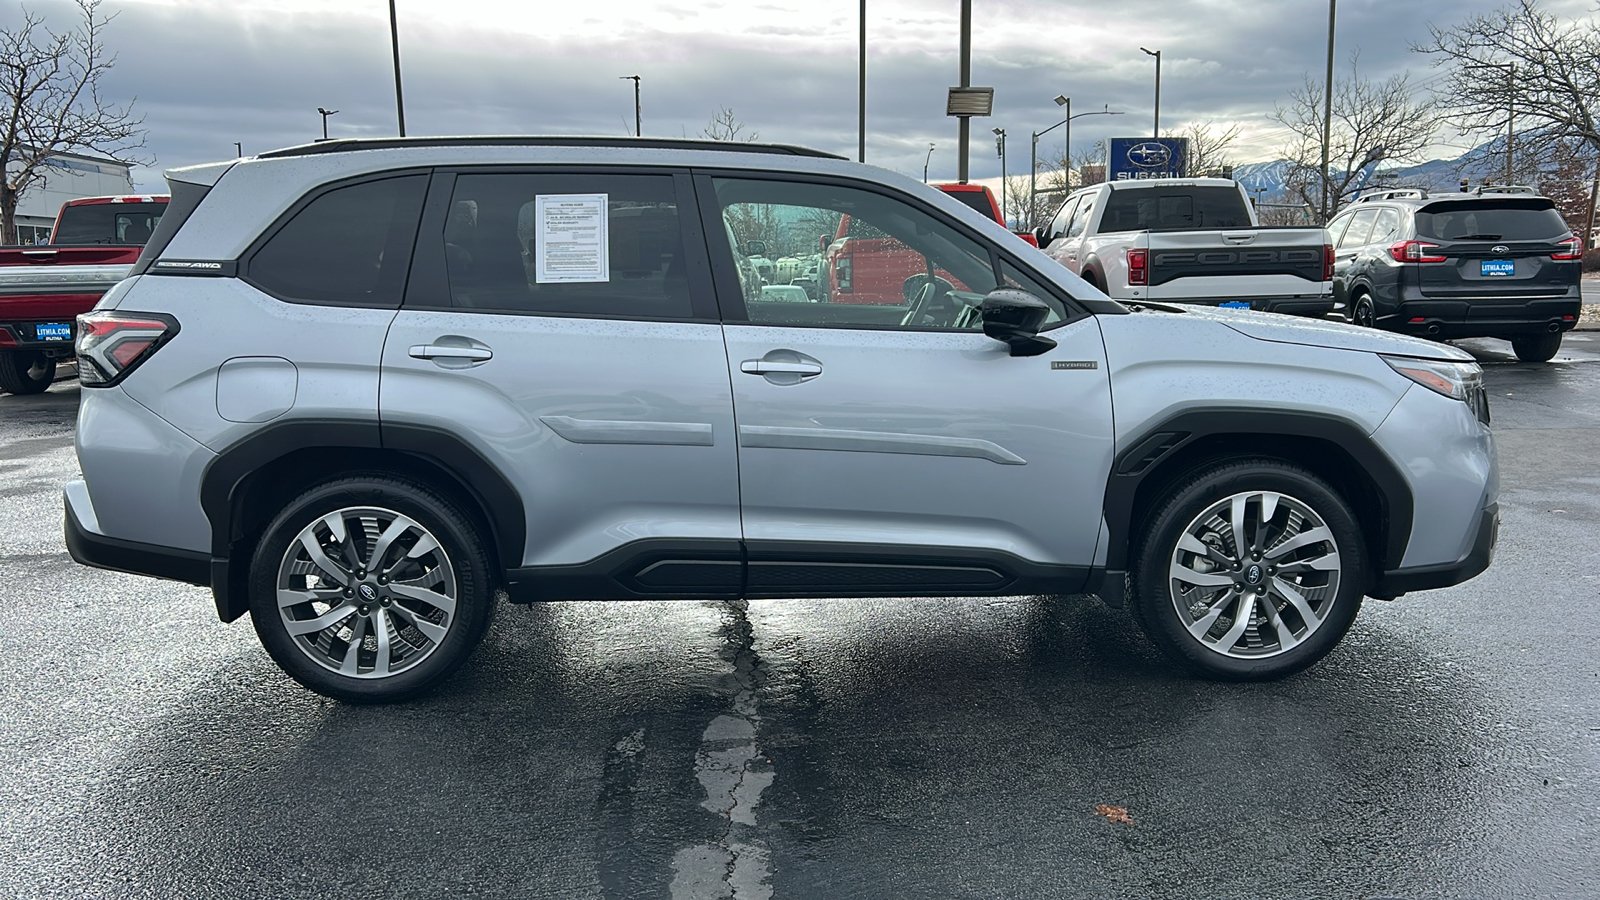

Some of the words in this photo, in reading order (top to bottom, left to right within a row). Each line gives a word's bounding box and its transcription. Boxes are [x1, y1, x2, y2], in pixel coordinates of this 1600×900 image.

[1117, 171, 1179, 180] SUBARU
[1154, 249, 1319, 266] FORD
[37, 328, 70, 336] LITHIA.COM
